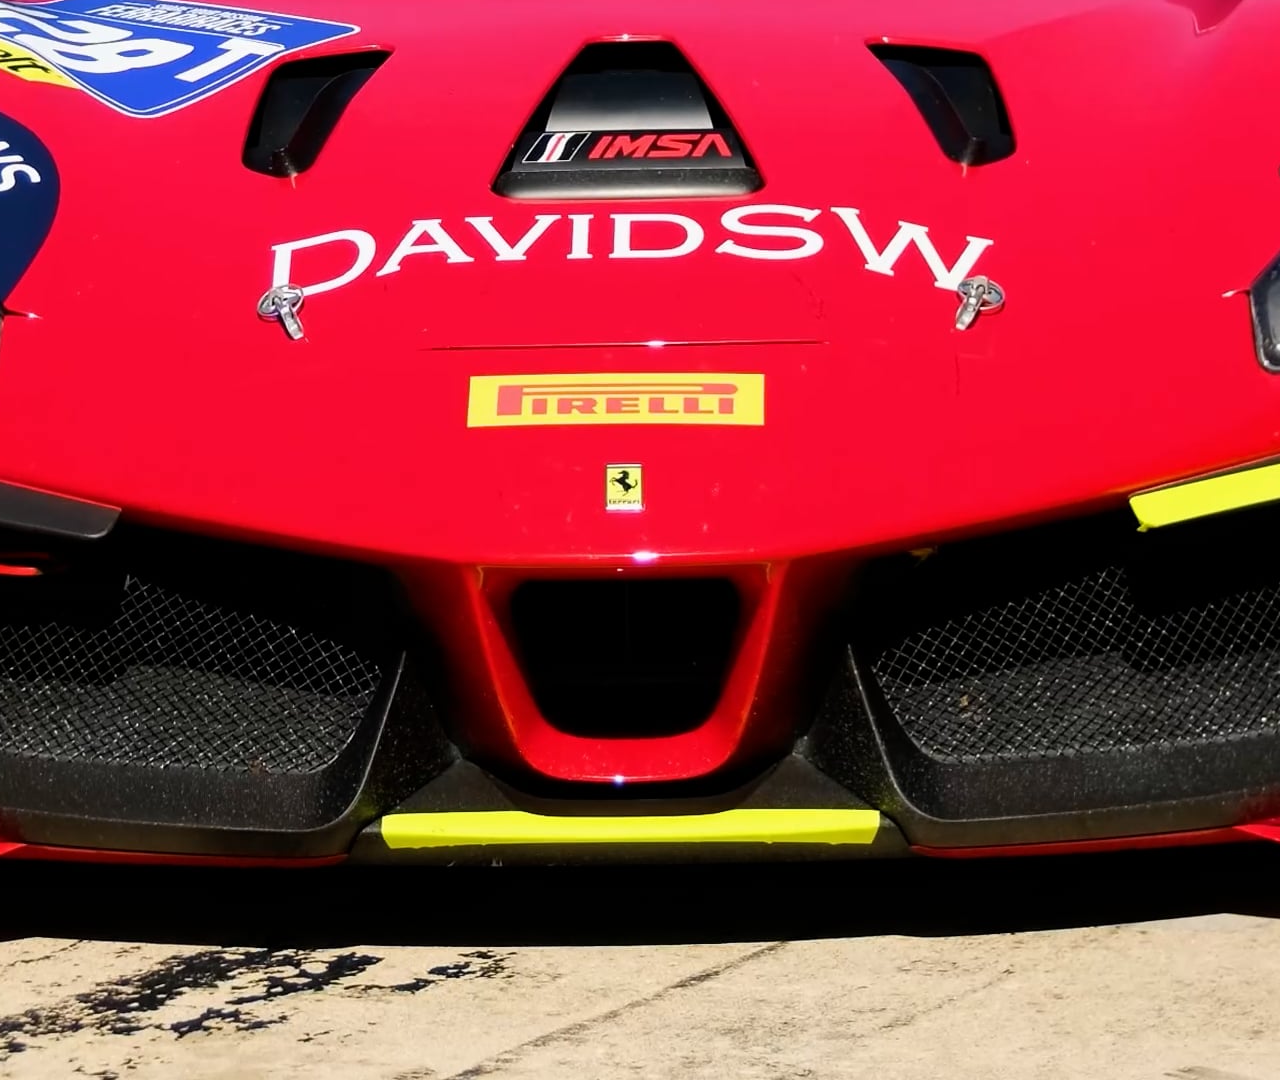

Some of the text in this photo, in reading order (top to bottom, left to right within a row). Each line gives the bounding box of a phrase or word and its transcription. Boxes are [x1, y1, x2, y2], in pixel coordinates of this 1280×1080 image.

[588, 133, 733, 160] IMSA
[270, 204, 994, 297] DAVIDSW
[496, 383, 738, 416] PIRELLI
